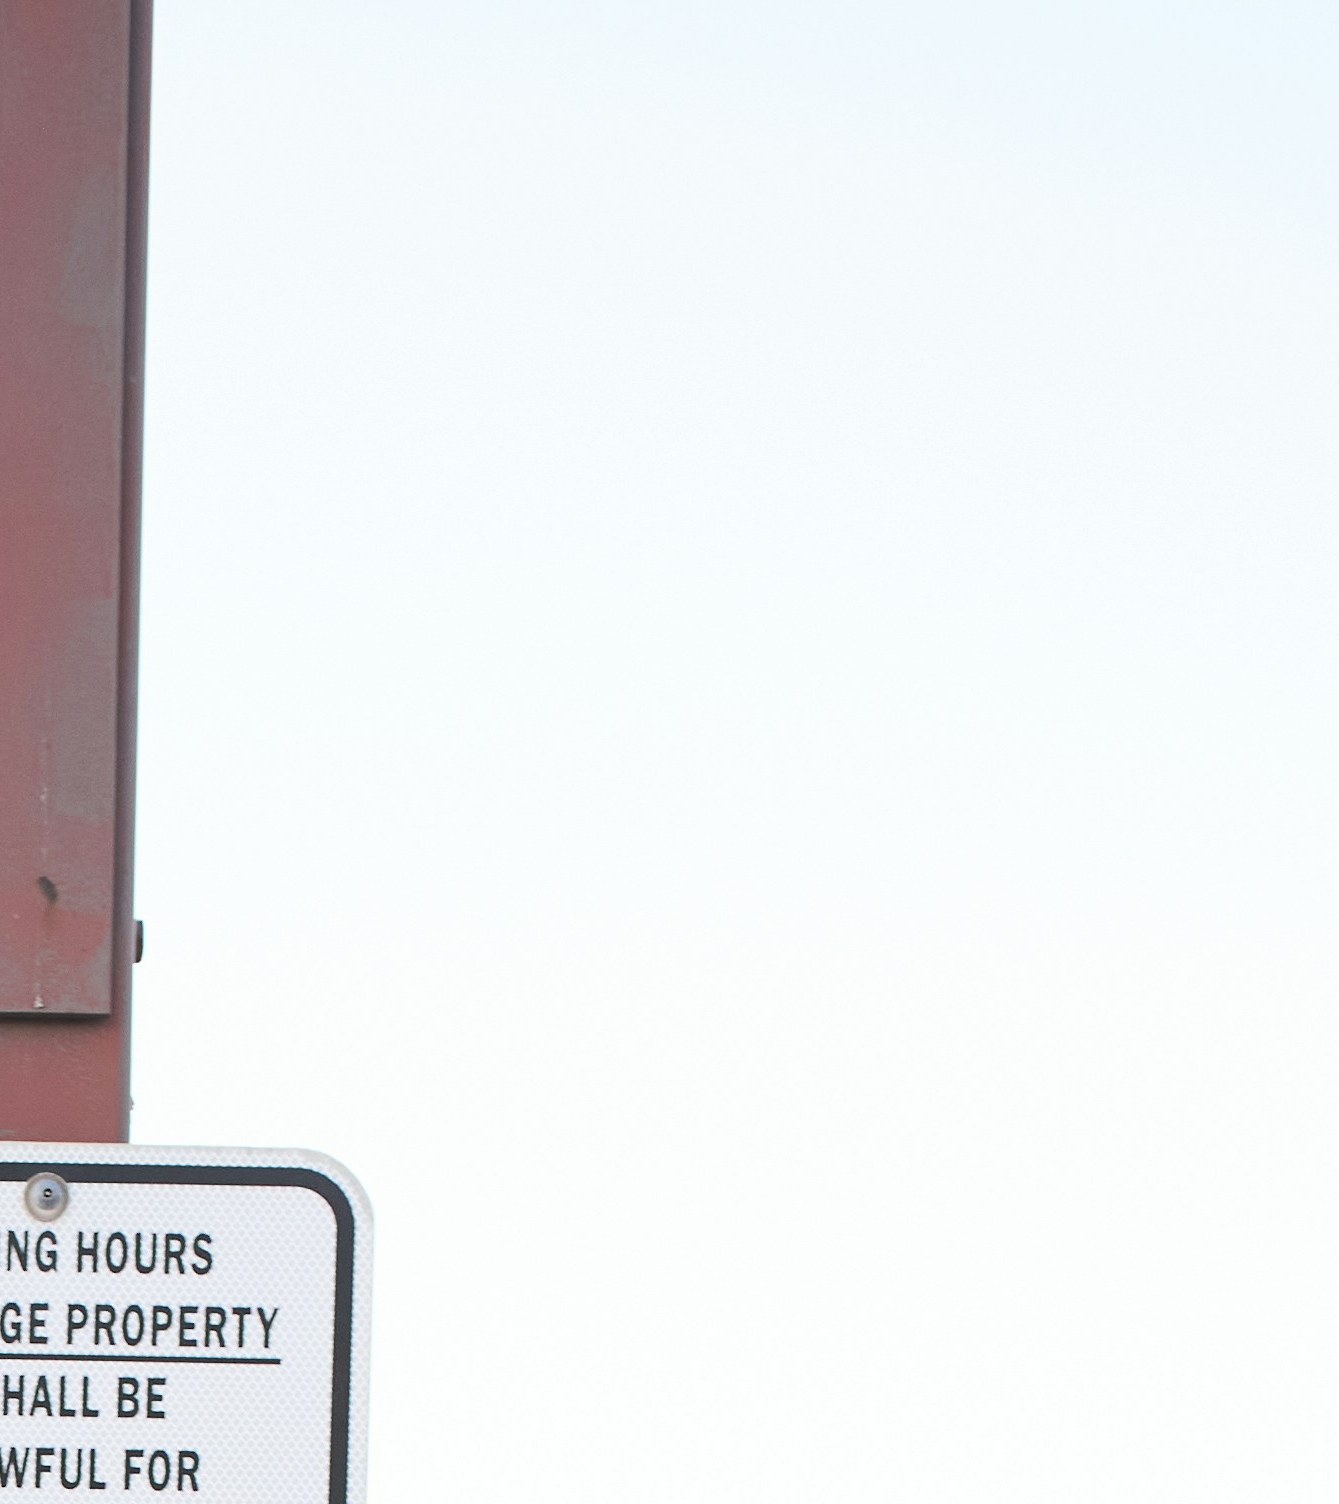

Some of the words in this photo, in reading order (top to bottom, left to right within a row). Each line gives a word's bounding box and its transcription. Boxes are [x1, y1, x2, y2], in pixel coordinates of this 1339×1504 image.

[76, 1231, 213, 1276] HOURS
[66, 1303, 279, 1349] PROPERTY
[117, 1376, 167, 1419] BE
[124, 1449, 200, 1492] FOR
